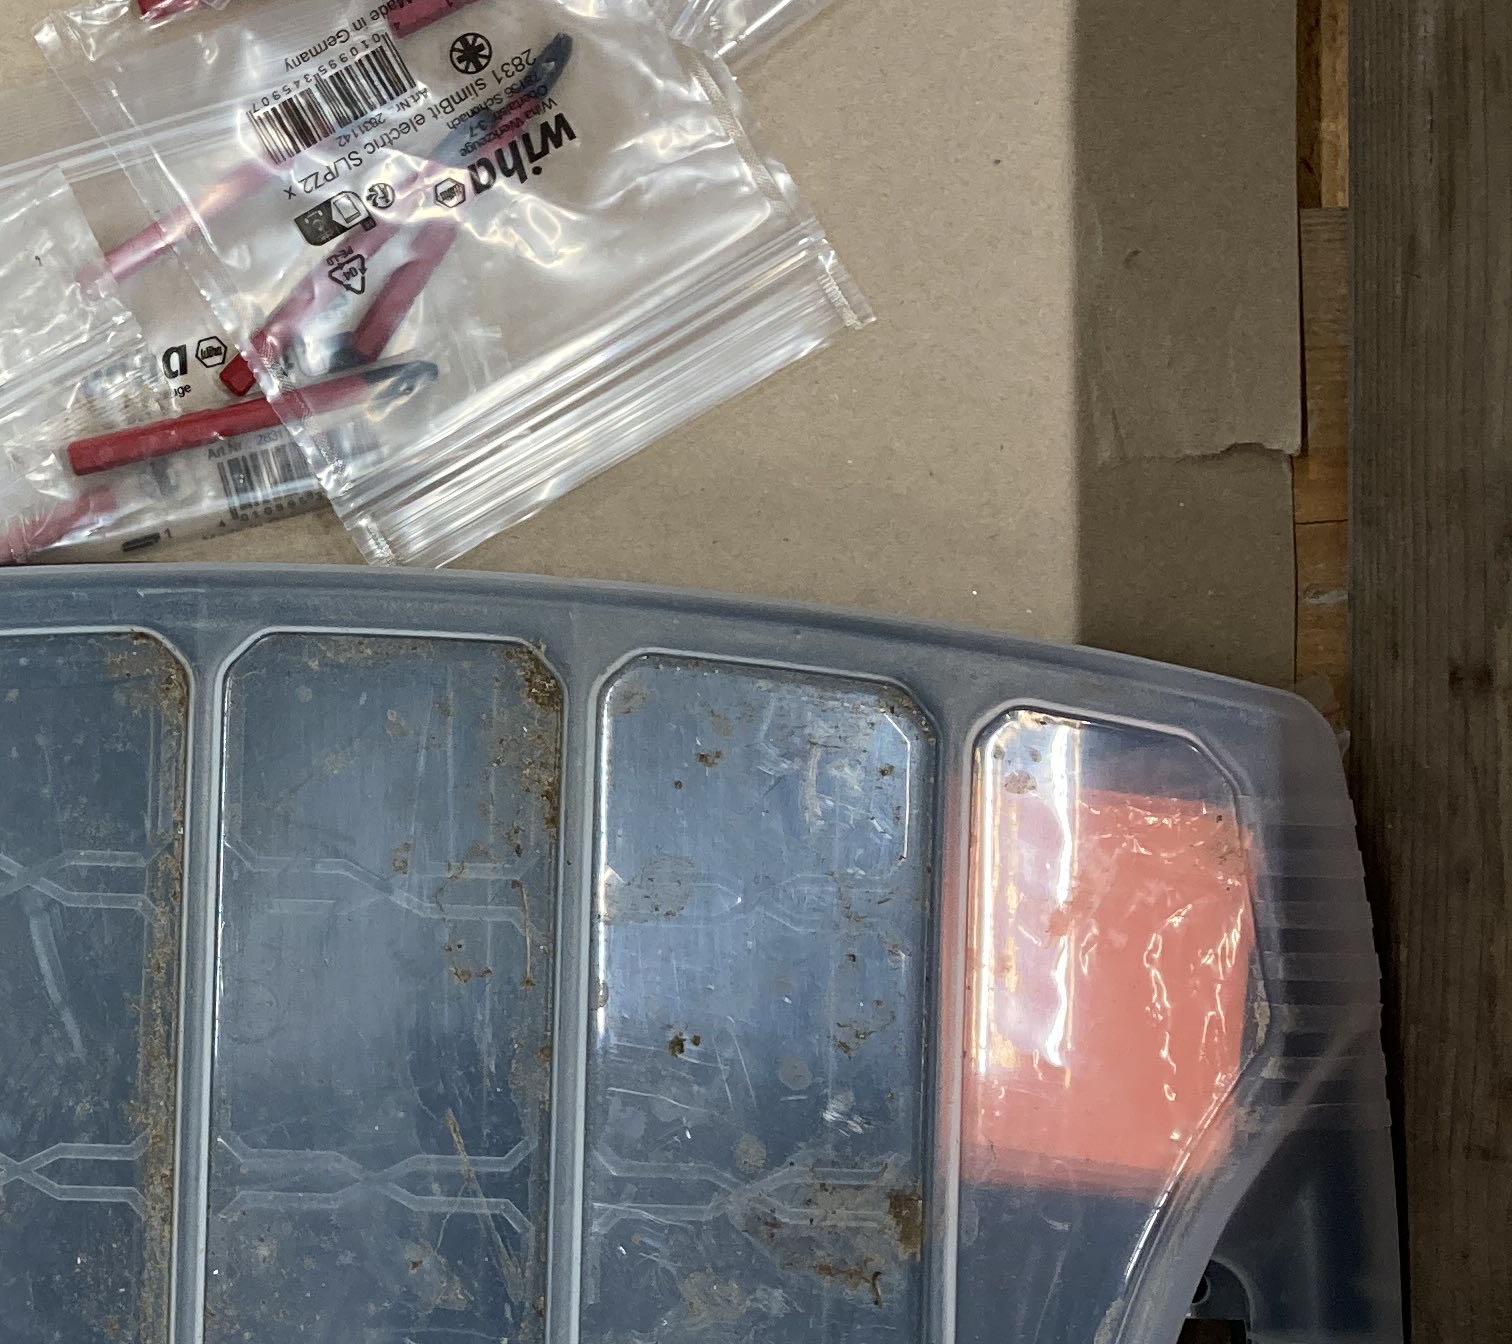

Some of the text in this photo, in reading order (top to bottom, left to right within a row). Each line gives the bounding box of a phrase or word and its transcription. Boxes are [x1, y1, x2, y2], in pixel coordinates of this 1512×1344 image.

[351, 16, 369, 33] in
[280, 23, 352, 75] Germany
[282, 46, 537, 199] 2831 slimBit electric SL/PZ2 x
[334, 110, 387, 149] 2831142
[446, 91, 504, 132] Schonach
[457, 94, 556, 160] Wiha Werkzeuge
[466, 119, 488, 138] 3-7
[462, 109, 583, 206] wiha
